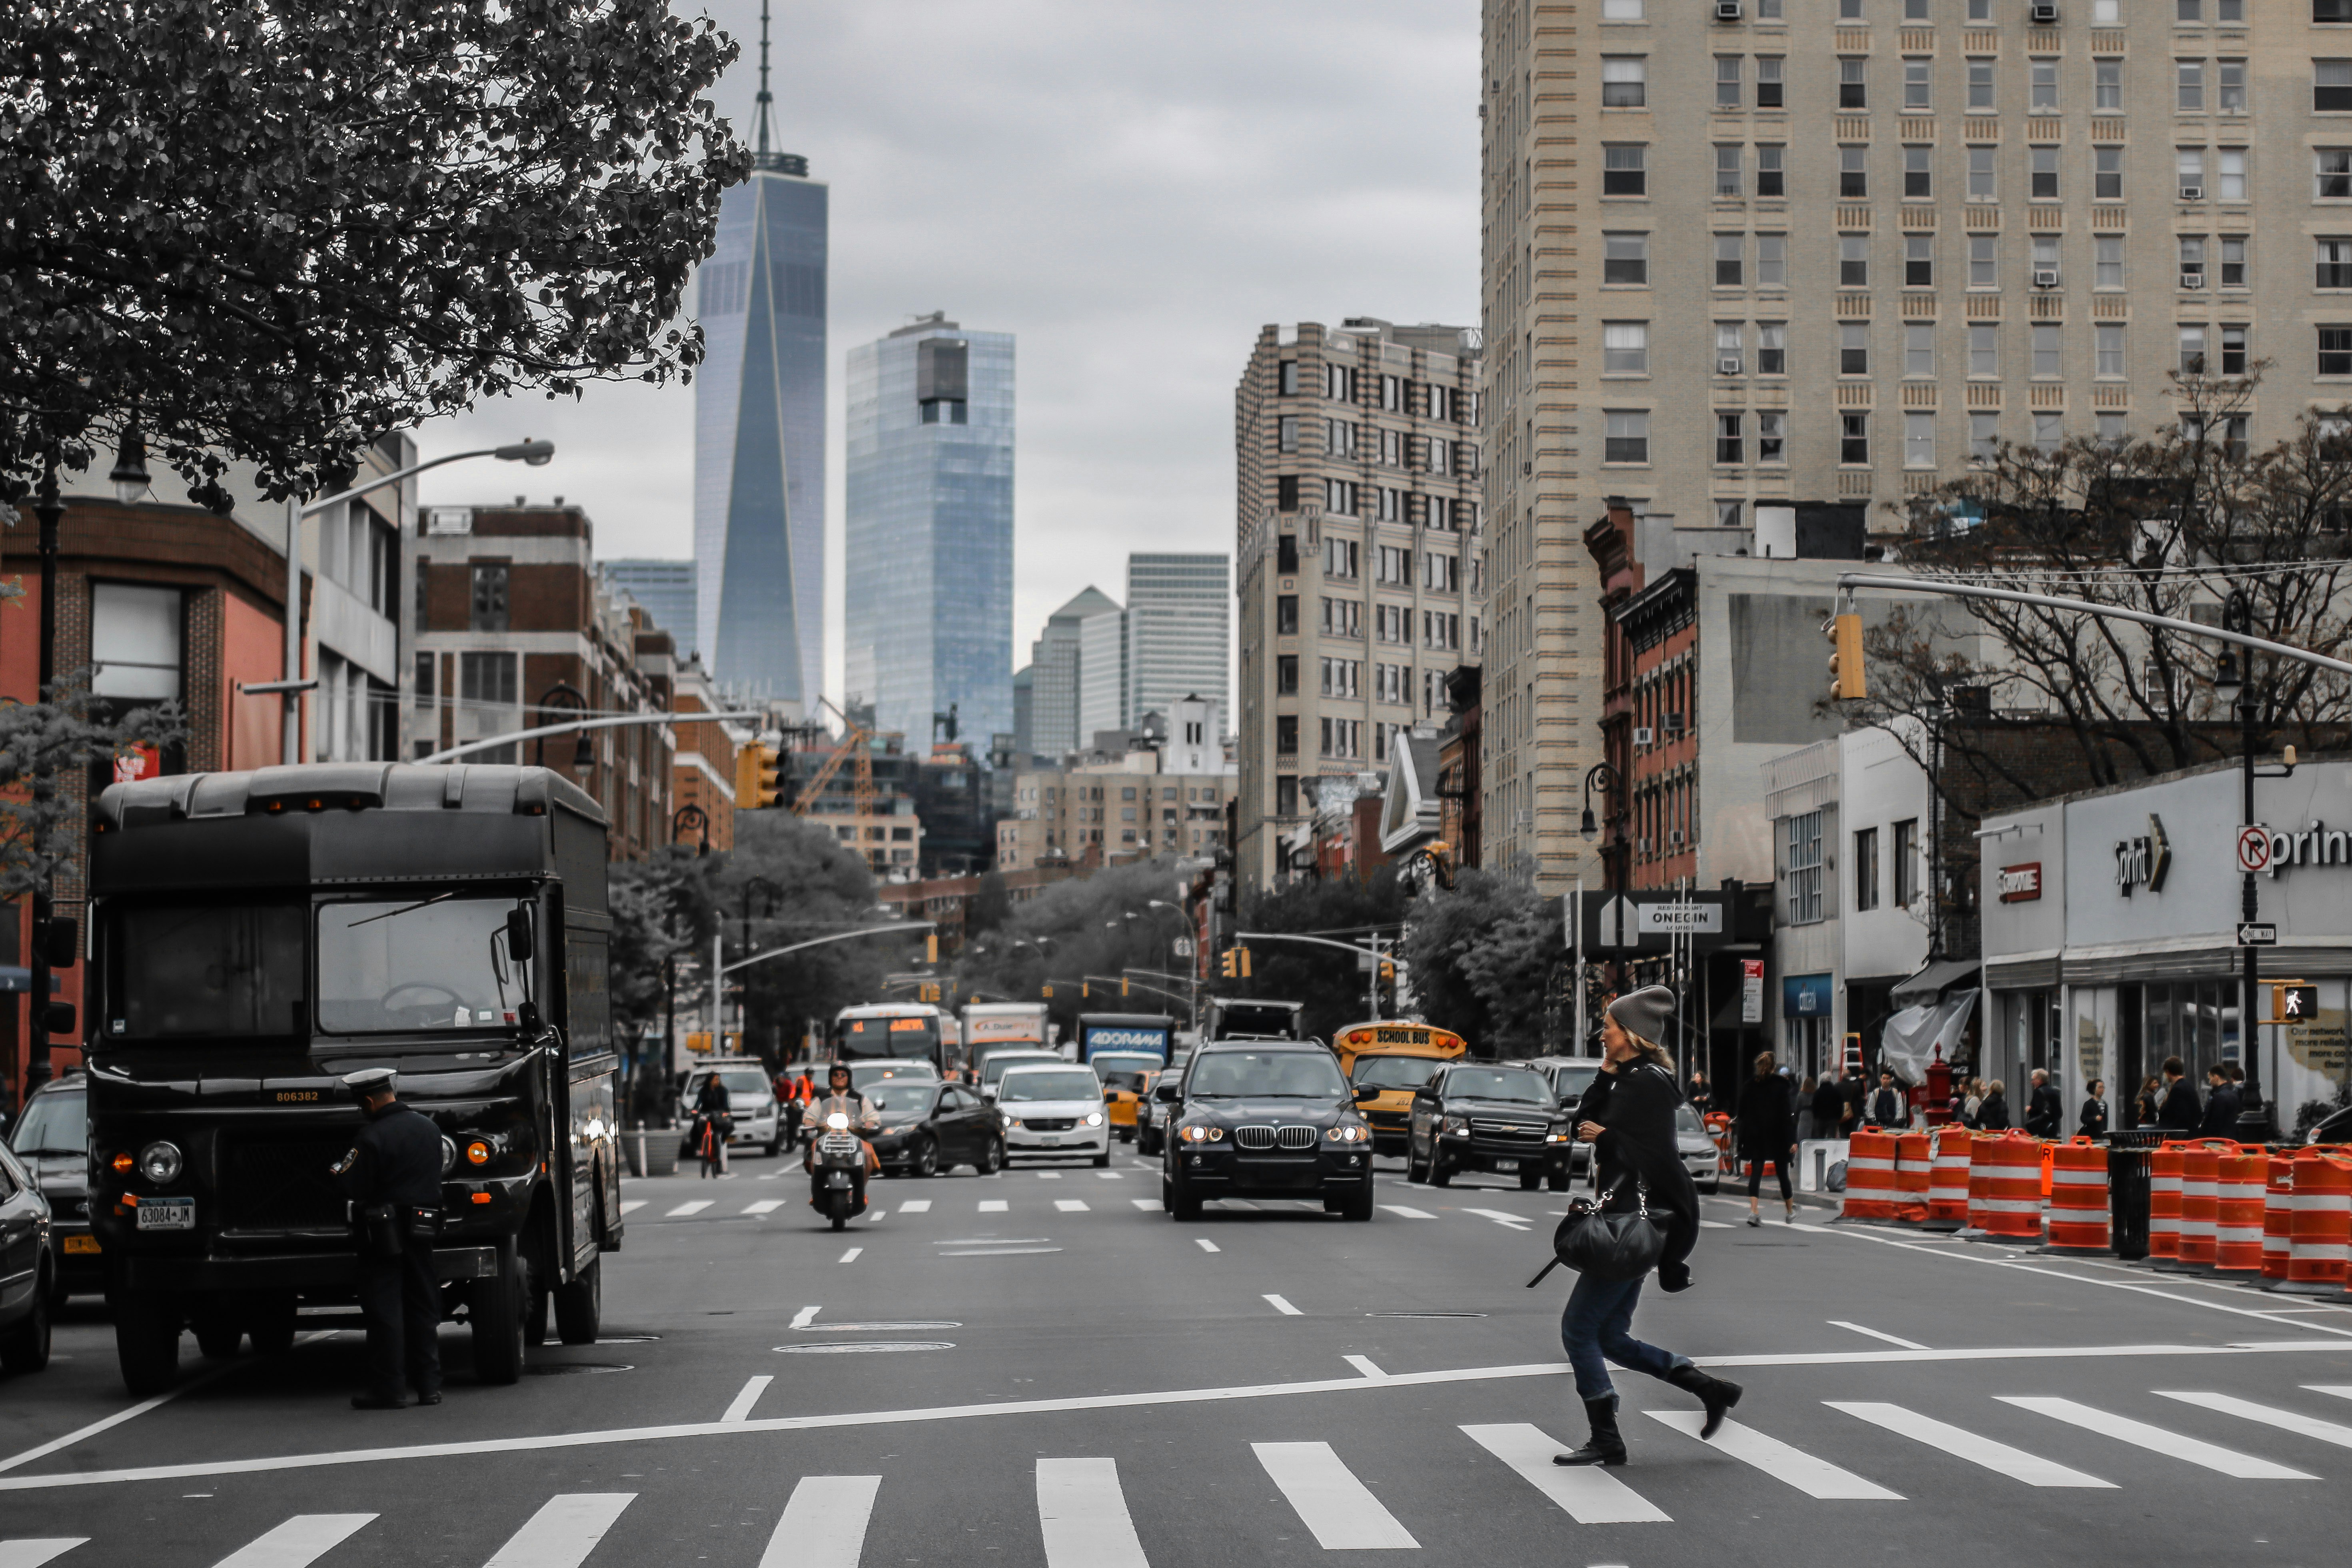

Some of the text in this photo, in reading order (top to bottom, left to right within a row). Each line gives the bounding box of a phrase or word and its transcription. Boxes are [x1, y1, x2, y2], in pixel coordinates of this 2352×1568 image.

[2268, 820, 2352, 877] prin
[2115, 837, 2147, 897] Sprint
[1653, 913, 1709, 923] ONEGIN
[2244, 929, 2273, 939] ONE WAY
[2310, 1027, 2346, 1035] network
[1090, 1032, 1163, 1046] ADORAMA
[1377, 1030, 1430, 1045] SCHOOL BUS
[277, 1092, 318, 1101] 806382
